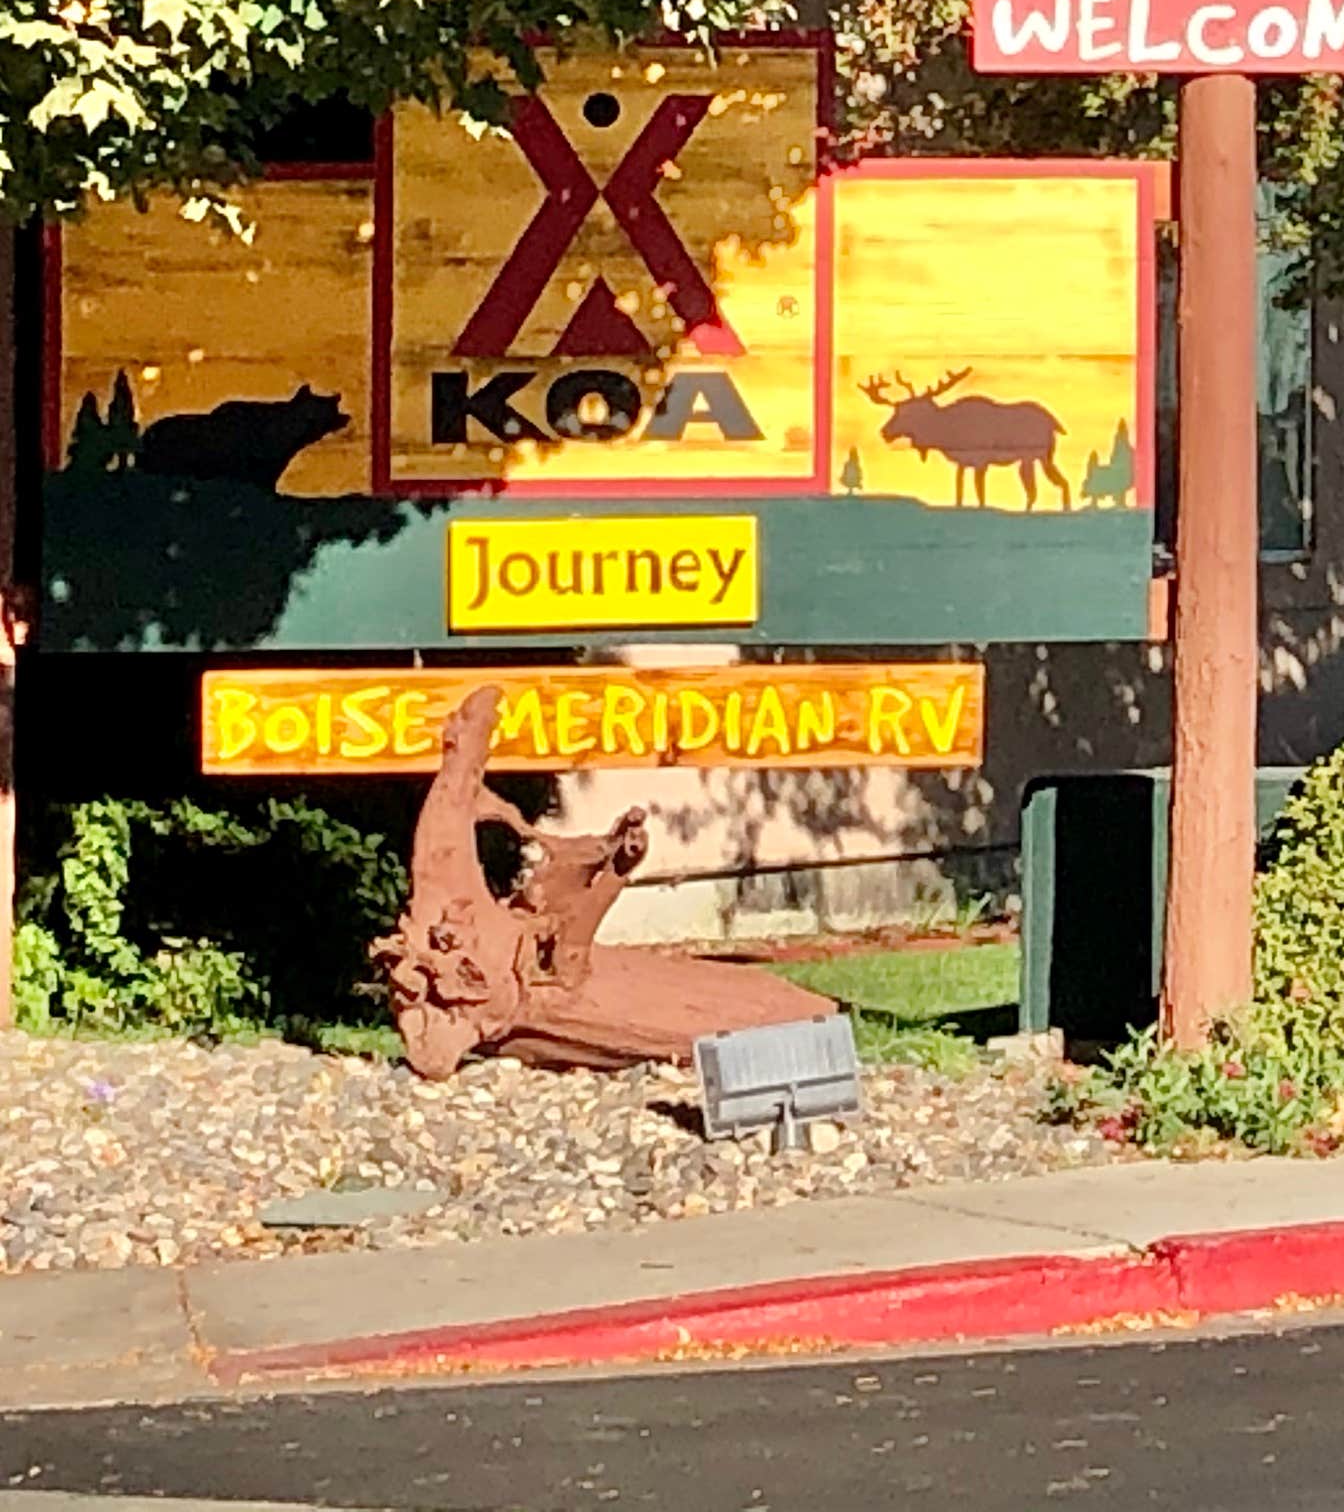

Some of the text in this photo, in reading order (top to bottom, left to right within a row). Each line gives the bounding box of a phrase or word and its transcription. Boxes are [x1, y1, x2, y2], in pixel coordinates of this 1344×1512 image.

[431, 369, 768, 444] KOA
[465, 536, 746, 610] Journey
[214, 684, 965, 759] BOISE MERIDIAN RV
